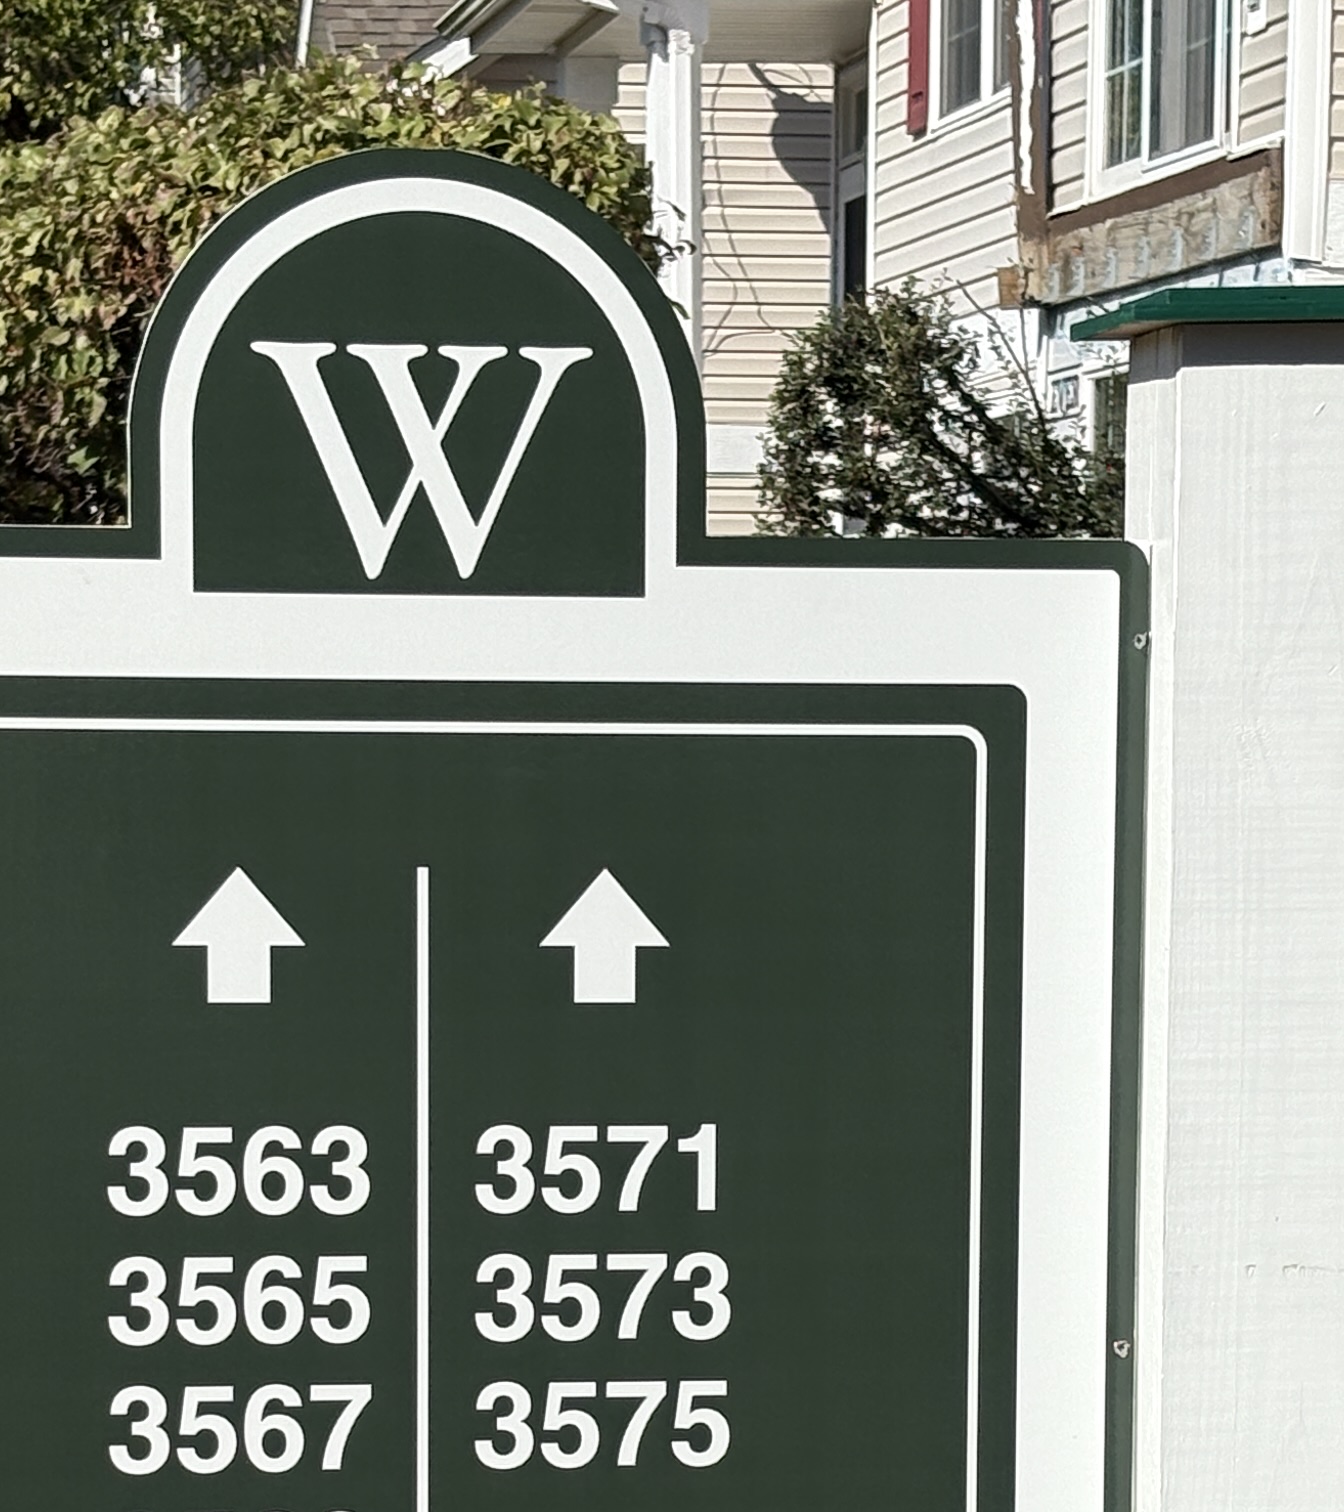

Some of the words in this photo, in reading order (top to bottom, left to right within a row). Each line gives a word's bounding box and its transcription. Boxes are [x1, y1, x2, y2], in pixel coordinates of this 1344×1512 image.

[248, 339, 594, 581] W
[107, 1125, 372, 1217] 3563
[474, 1124, 717, 1215] 3571
[107, 1254, 372, 1347] 3565
[474, 1251, 731, 1343] 3573
[108, 1382, 373, 1475] 3567
[474, 1380, 731, 1470] 3575
